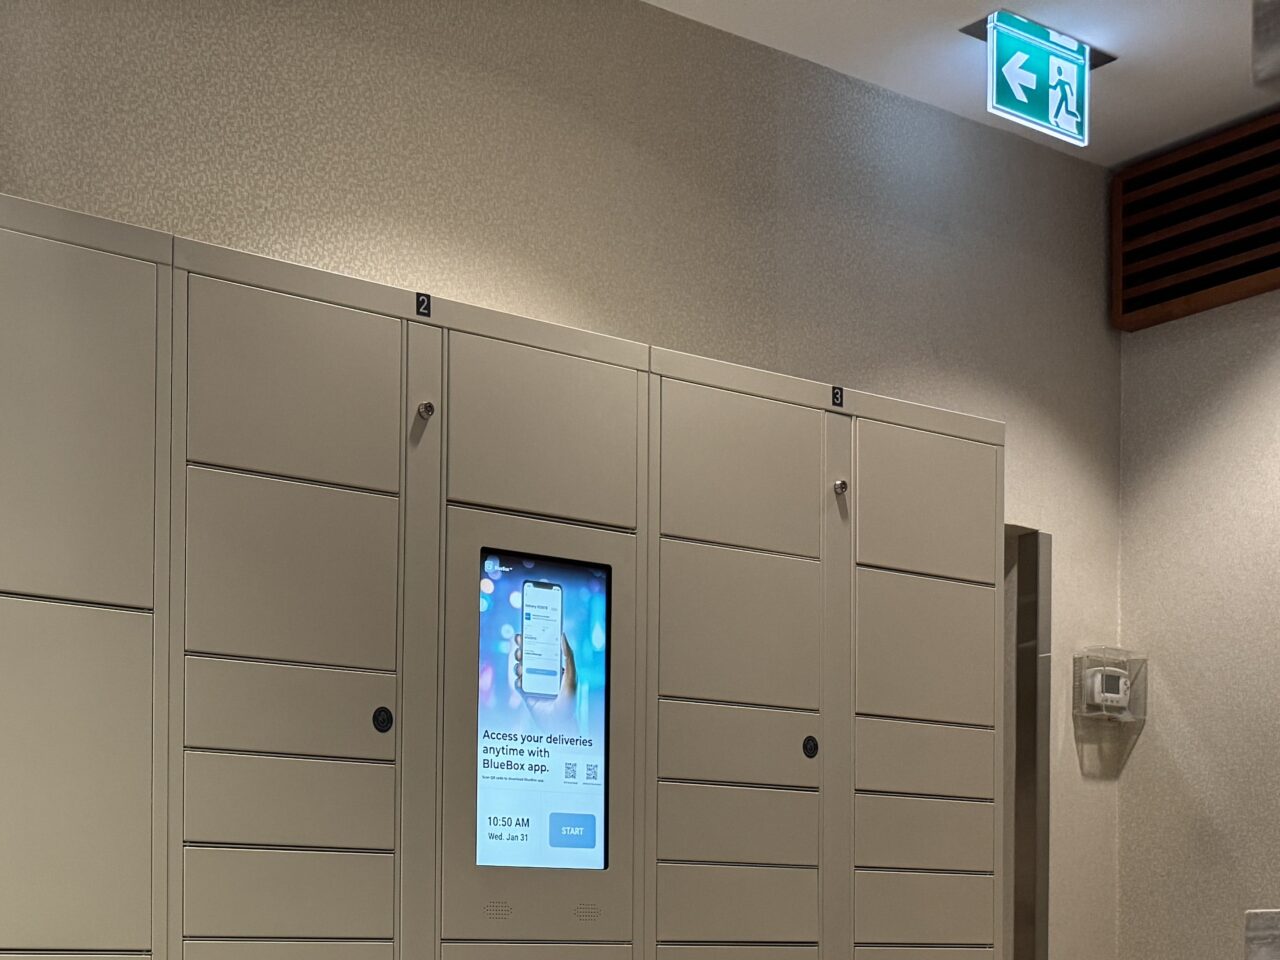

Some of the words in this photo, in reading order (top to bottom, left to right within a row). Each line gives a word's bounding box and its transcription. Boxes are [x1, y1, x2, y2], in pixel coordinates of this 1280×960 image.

[419, 296, 428, 313] 2
[834, 389, 841, 404] 3
[482, 729, 518, 741] Access
[520, 734, 544, 744] your
[546, 734, 593, 747] deliveries
[482, 745, 525, 757] anytime
[527, 747, 550, 758] with
[482, 759, 525, 771] BlueBox
[527, 763, 550, 775] app.
[488, 816, 512, 827] 10:50
[515, 818, 530, 827] AM
[488, 832, 505, 841] Wed.
[506, 834, 519, 842] Jan
[561, 827, 584, 835] START
